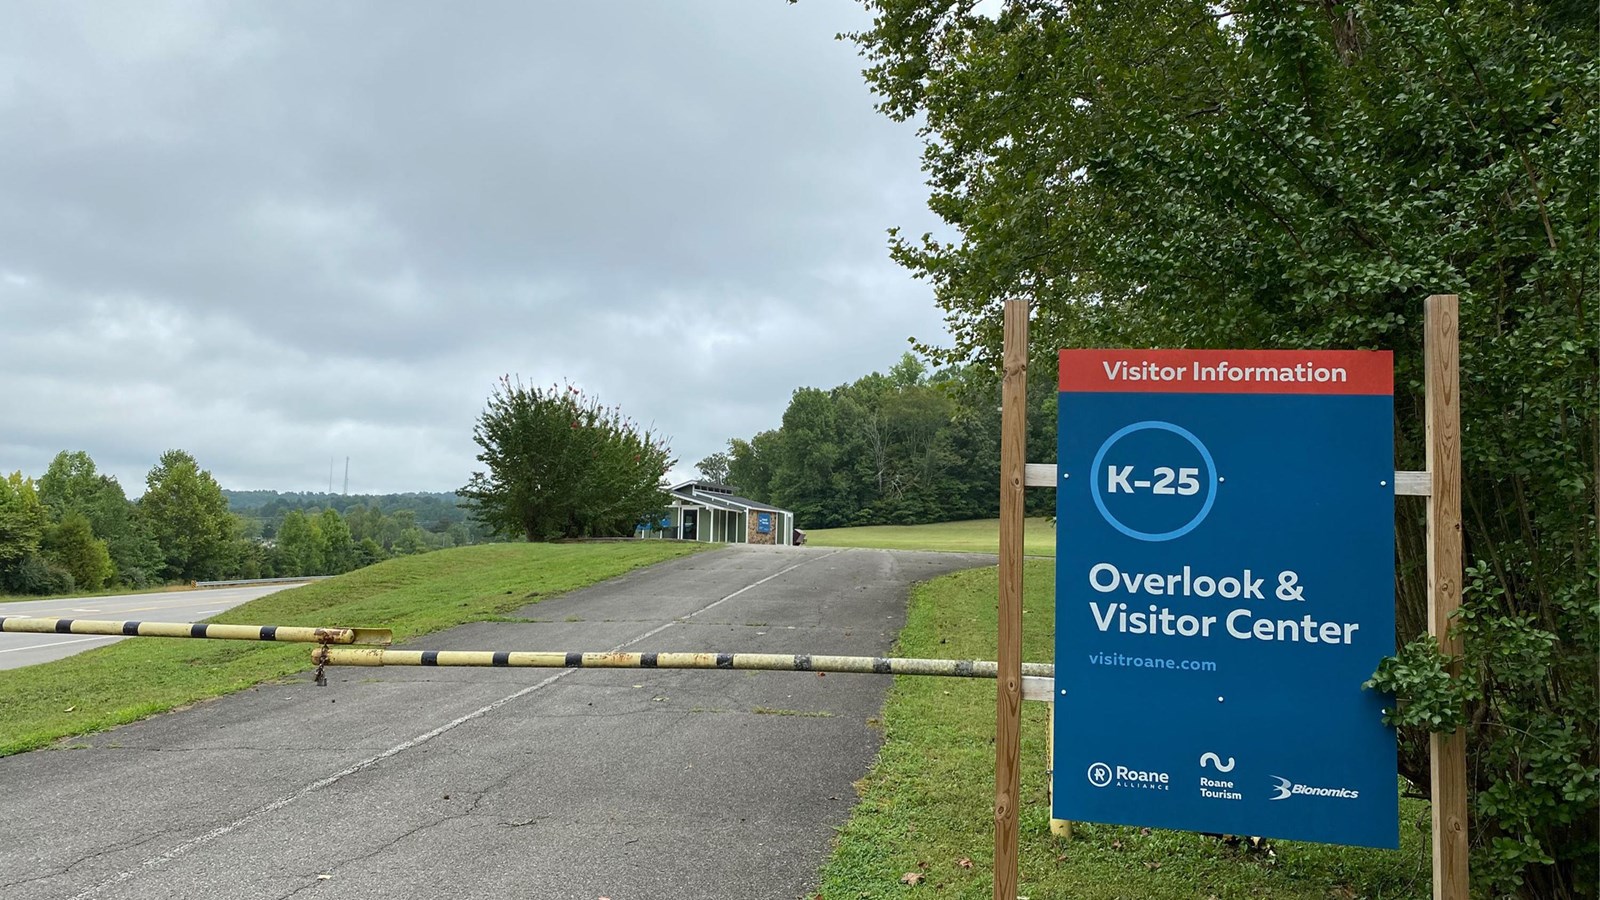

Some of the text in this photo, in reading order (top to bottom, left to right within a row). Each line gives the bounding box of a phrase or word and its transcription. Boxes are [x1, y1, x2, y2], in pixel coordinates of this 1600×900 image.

[1102, 361, 1347, 383] Visitor Information
[1107, 465, 1200, 496] K-25
[1089, 562, 1306, 602] Overlook &
[1089, 601, 1360, 645] Visitor Center
[1088, 652, 1217, 671] visitroane.com
[1116, 765, 1170, 784] Roane
[1199, 777, 1234, 789] Roane
[1116, 781, 1170, 791] ALLIANCE
[1199, 788, 1242, 801] Tourism
[1291, 784, 1360, 800] Bionomics
